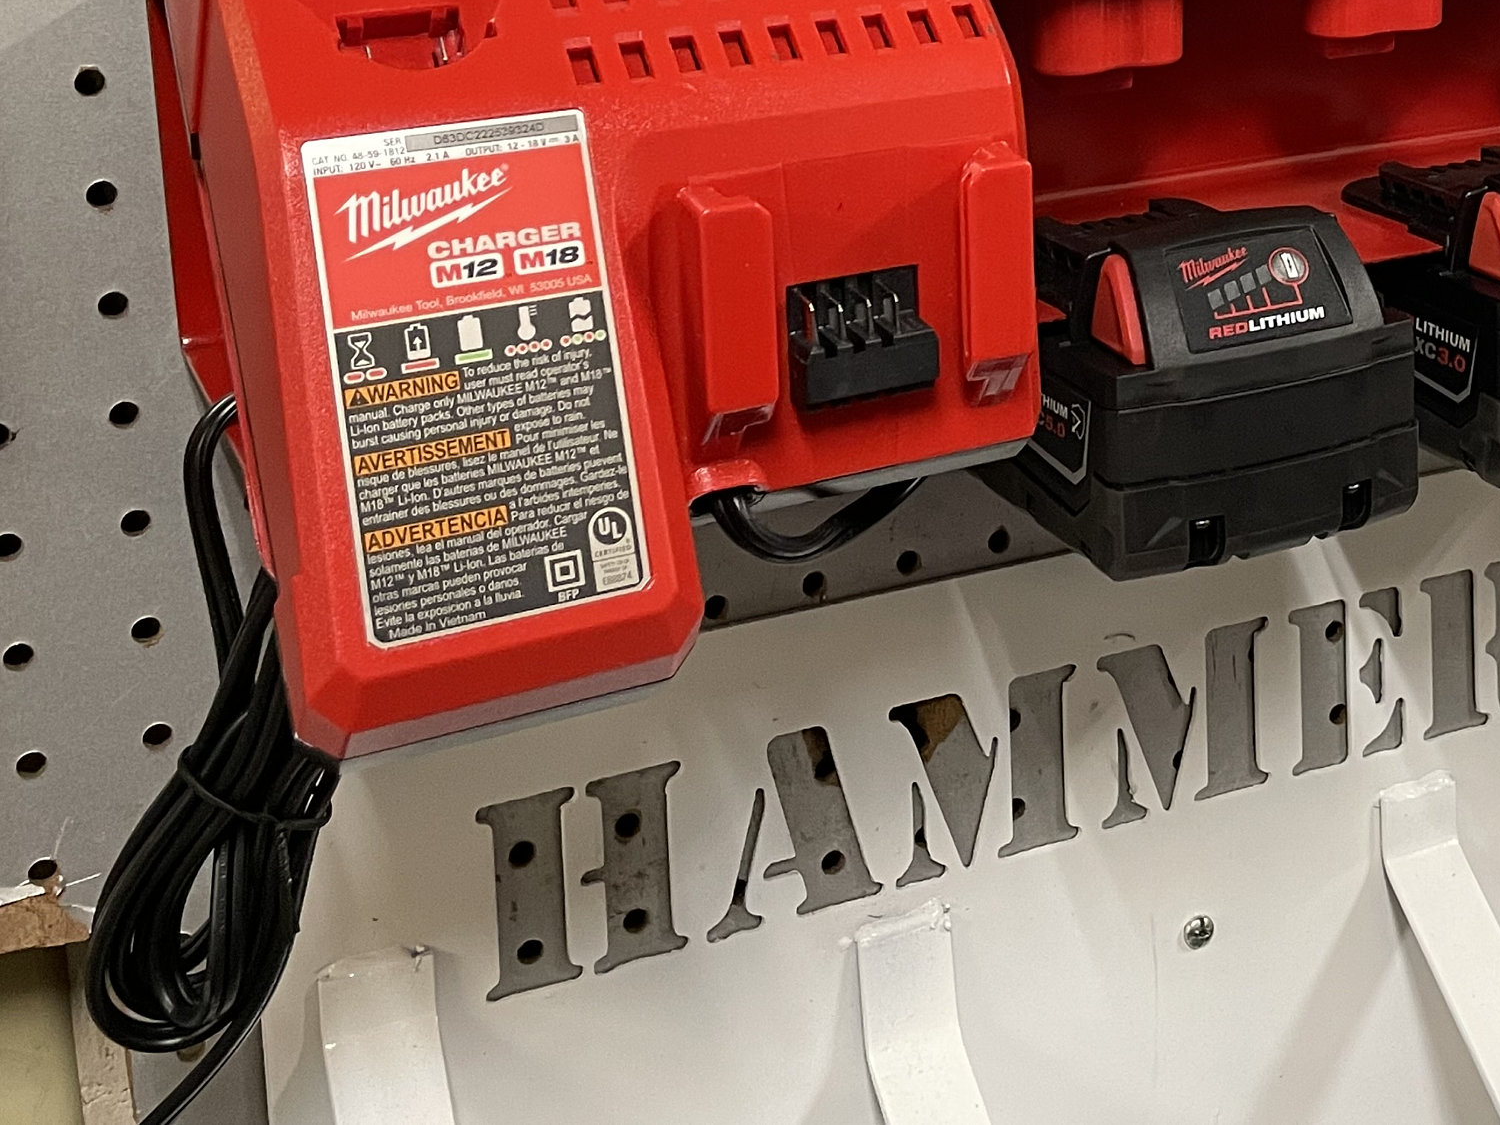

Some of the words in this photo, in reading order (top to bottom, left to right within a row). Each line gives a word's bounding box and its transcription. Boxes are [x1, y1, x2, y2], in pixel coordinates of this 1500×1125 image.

[349, 161, 366, 171] 120
[390, 157, 401, 166] 60
[334, 167, 508, 244] Milwaukee
[427, 221, 582, 260] CHARGER
[435, 258, 498, 284] M12
[519, 245, 580, 270] M18
[1177, 246, 1248, 284] Milwaukee
[351, 303, 413, 322] Milwaukee
[567, 274, 592, 288] USA
[1208, 305, 1326, 340] REDLITHIUM
[462, 366, 474, 377] To
[477, 362, 511, 375] reduce
[513, 358, 529, 369] the
[531, 354, 549, 365] risk
[551, 350, 561, 362] of
[1414, 335, 1466, 373] XC3.0
[367, 373, 457, 402] WARNING
[392, 401, 430, 415] Charge
[433, 395, 454, 408] only
[457, 382, 522, 403] MILWAUKEE
[560, 372, 578, 385] and
[464, 378, 486, 390] user
[488, 372, 513, 385] must
[515, 367, 538, 381] read
[351, 435, 378, 449] burst
[381, 429, 421, 443] causing
[423, 418, 467, 438] personal
[469, 415, 496, 428] injury
[557, 400, 572, 411] Do
[574, 396, 590, 407] not
[382, 417, 417, 430] battery
[420, 410, 453, 426] packs.
[456, 404, 484, 416] Other
[486, 399, 514, 413] types
[528, 389, 571, 403] batteries
[573, 385, 593, 395] may
[1042, 393, 1068, 420] HIUM
[514, 418, 550, 432] expose
[515, 432, 539, 444] Pour
[590, 420, 605, 429] les
[357, 474, 389, 487] risque
[391, 469, 405, 480] de
[462, 455, 485, 466] lisez
[532, 442, 545, 453] de
[603, 429, 618, 439] Ne
[358, 430, 505, 472] AVERTISSEMENT
[358, 484, 398, 500] charger
[401, 481, 421, 493] que
[423, 477, 439, 487] les
[441, 468, 485, 484] batteries
[487, 453, 552, 474] MILWAUKEE
[432, 483, 475, 498] D'autres
[478, 474, 521, 489] marques
[523, 470, 537, 480] de
[538, 462, 581, 477] batteries
[411, 505, 430, 516] des
[432, 495, 481, 511] blessures
[499, 487, 518, 498] des
[510, 509, 535, 521] Para
[537, 502, 570, 515] reducir
[584, 493, 614, 506] riesgo
[369, 509, 505, 549] ADVERTENCIA
[415, 543, 432, 554] lea
[446, 530, 484, 547] manual
[486, 526, 502, 539] del
[554, 511, 587, 525] Cargar
[598, 517, 622, 538] UL
[369, 558, 422, 577] solamente
[425, 554, 441, 565] las
[502, 526, 566, 548] MILWAUKEE
[487, 554, 507, 565] Las
[372, 590, 399, 603] otras
[401, 581, 439, 596] marcas
[442, 573, 480, 590] pueden
[483, 562, 526, 581] provocar
[374, 600, 417, 615] lesiones
[420, 586, 476, 608] personales
[558, 588, 579, 602] BFP
[375, 615, 402, 629] Evite
[388, 624, 422, 639] Made
[438, 611, 486, 627] Vietnam
